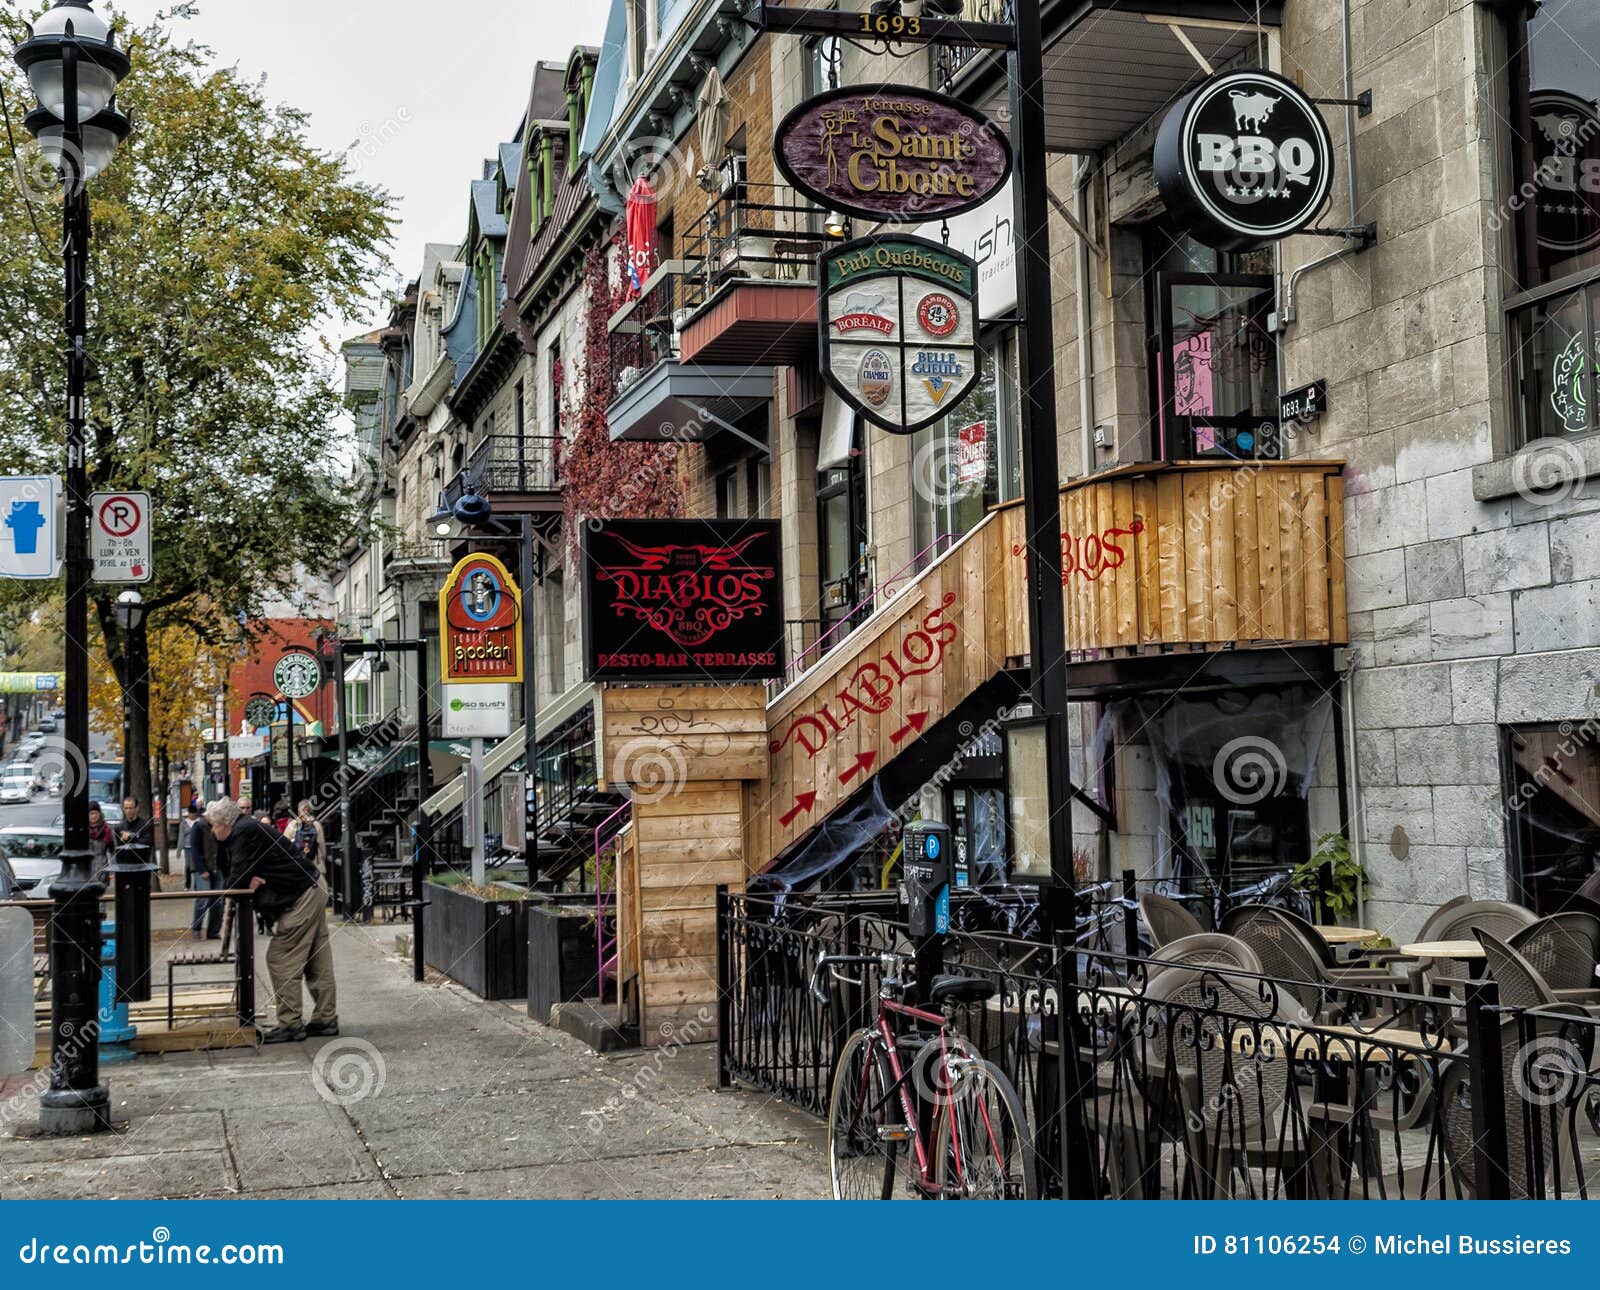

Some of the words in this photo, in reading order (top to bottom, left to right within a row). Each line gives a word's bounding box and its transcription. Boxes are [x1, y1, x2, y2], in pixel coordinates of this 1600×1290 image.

[859, 13, 921, 35] 1693
[862, 98, 930, 115] Terrasse
[850, 132, 875, 149] Le
[1197, 133, 1315, 186] BBQ
[847, 150, 975, 197] Ciboire
[836, 251, 871, 277] Pub
[875, 247, 965, 284] Québécois
[837, 315, 893, 333] BORÉALE
[918, 351, 957, 364] BELLE
[911, 362, 963, 377] GUEULE
[1282, 399, 1299, 418] 1693
[596, 570, 775, 608] DIABLOS
[276, 654, 318, 676] STARBUCKS
[597, 653, 689, 668] RESTO-BAR
[693, 652, 776, 667] TERRASSE
[768, 592, 958, 760] DIABLOS
